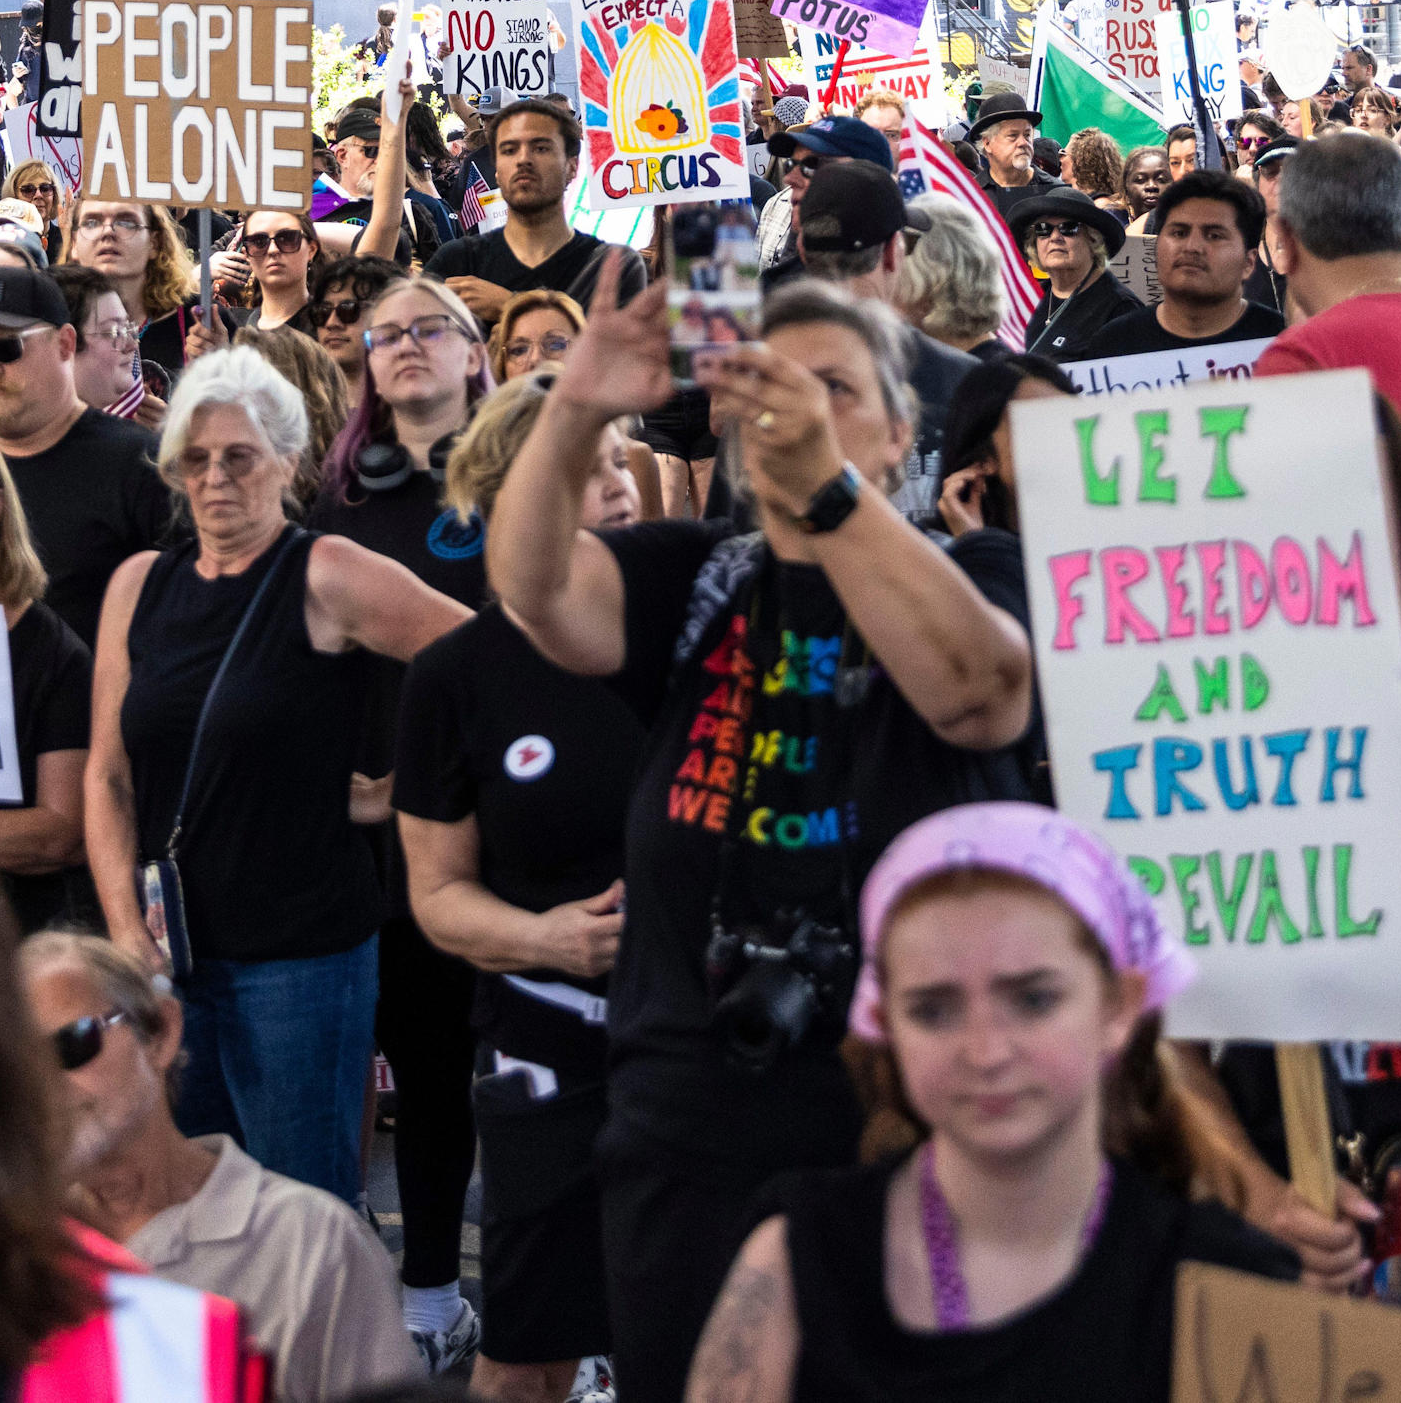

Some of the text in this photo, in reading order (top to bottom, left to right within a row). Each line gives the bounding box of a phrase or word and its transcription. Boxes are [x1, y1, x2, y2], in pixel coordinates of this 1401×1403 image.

[446, 9, 496, 52] NO
[506, 18, 541, 33] STAND
[671, 0, 684, 18] A
[85, 0, 309, 104] PEOPLE
[507, 30, 544, 44] STRONG
[456, 47, 547, 95] KINGS
[881, 74, 932, 100] WAY
[1173, 63, 1225, 100] KNG
[89, 101, 305, 208] ALONE
[602, 151, 722, 200] CIRCUS
[1074, 404, 1251, 507] LET
[1047, 530, 1378, 652] FREEDOM
[1135, 651, 1273, 722] AND
[1092, 726, 1369, 821] TRUTH
